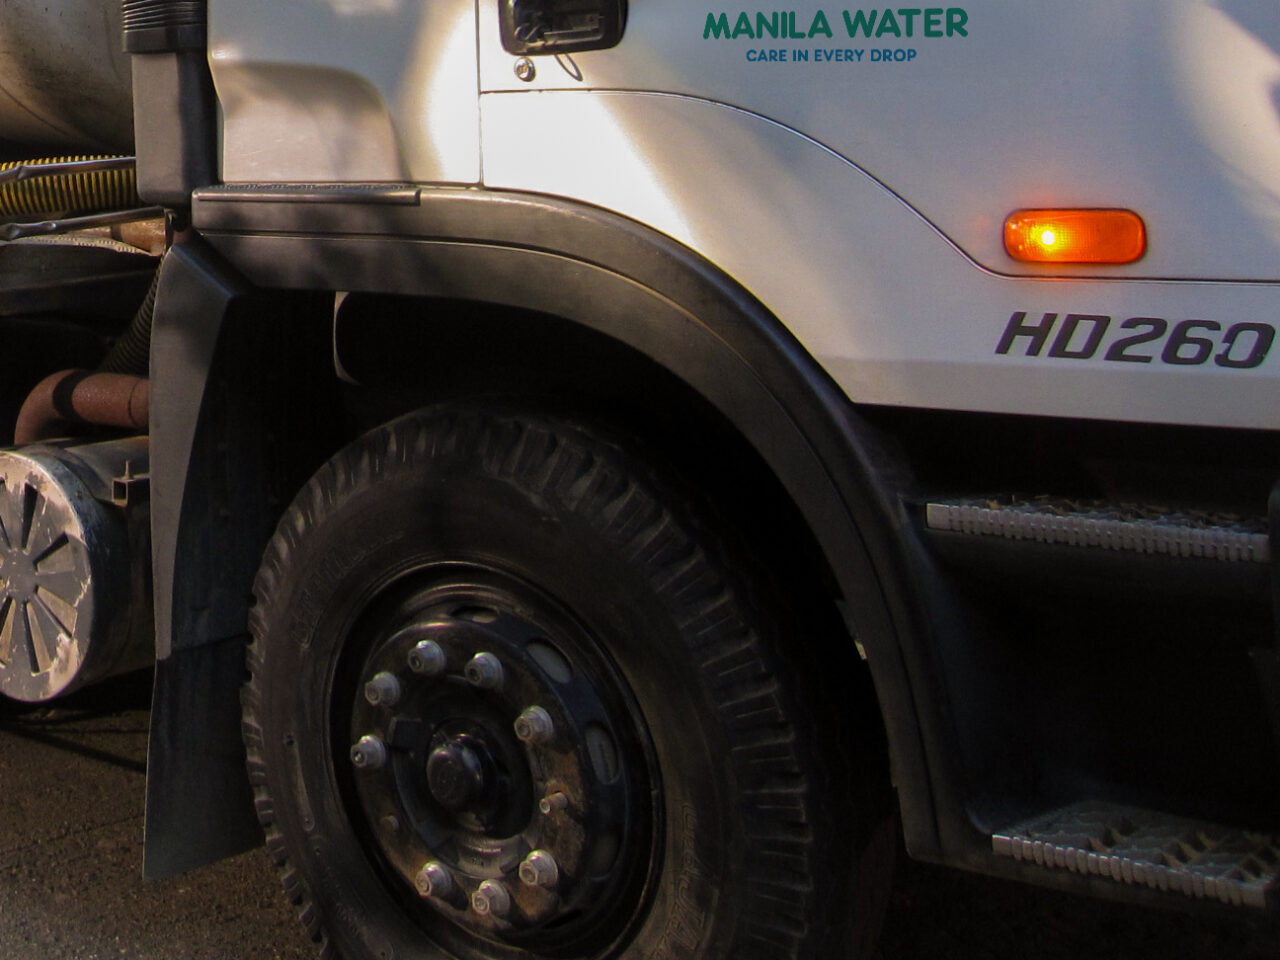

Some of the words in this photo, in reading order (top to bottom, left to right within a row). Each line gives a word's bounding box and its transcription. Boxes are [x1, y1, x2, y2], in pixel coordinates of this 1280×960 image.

[703, 9, 833, 39] MANILA
[842, 8, 969, 38] WATER
[746, 49, 787, 62] CARE
[792, 49, 809, 62] IN
[814, 49, 865, 62] EVERY
[870, 49, 917, 62] DROP
[994, 311, 1276, 369] HD260
